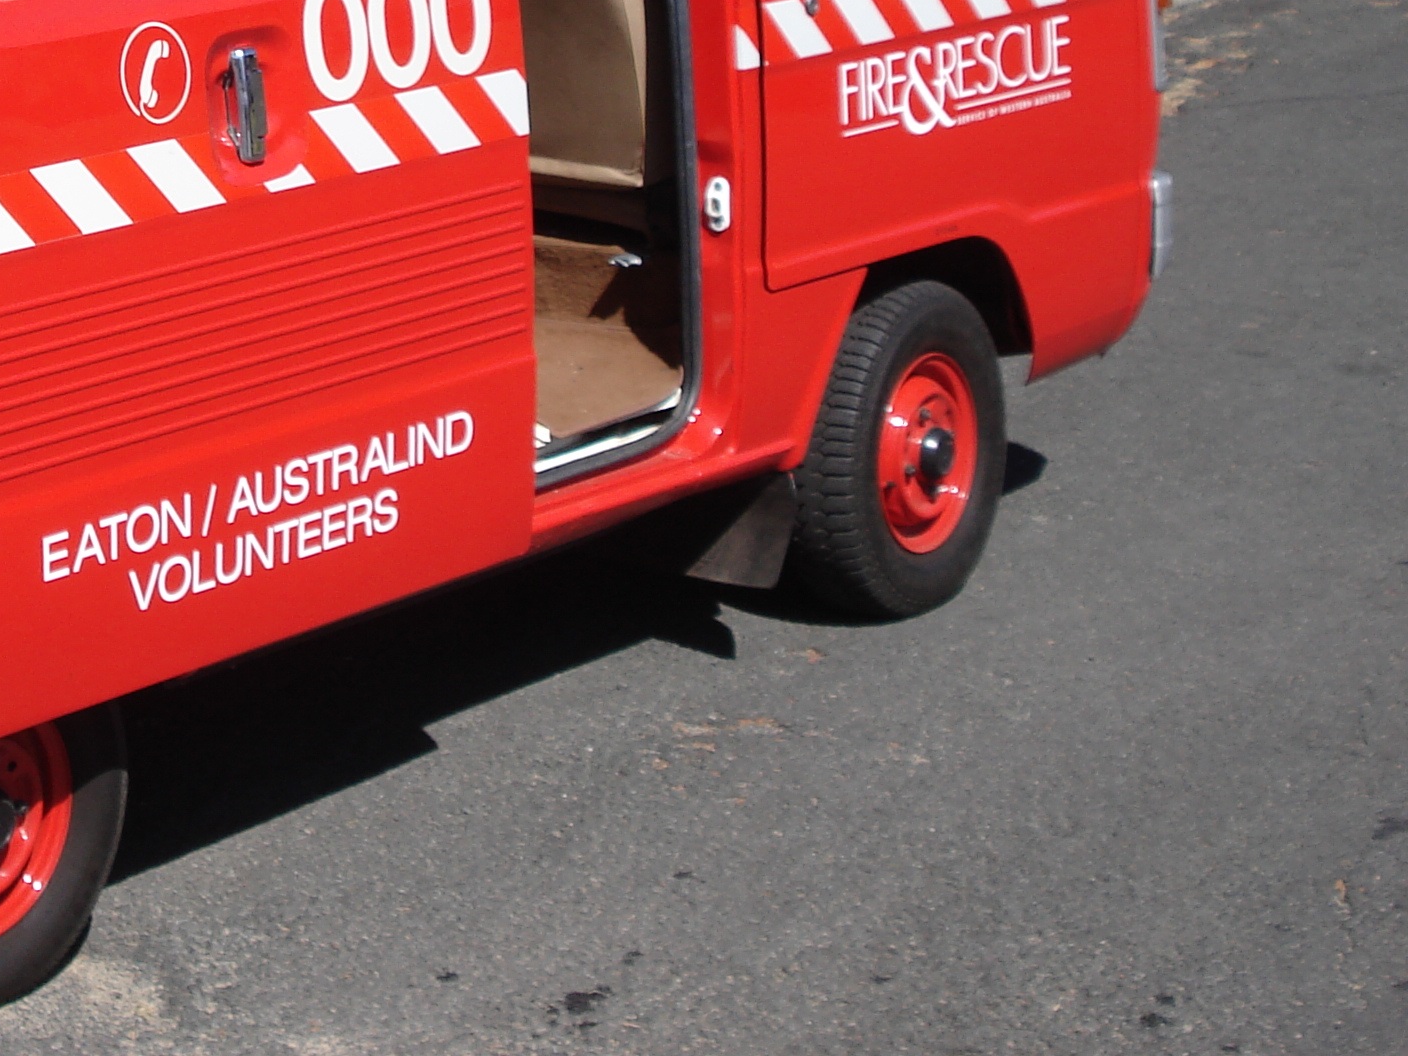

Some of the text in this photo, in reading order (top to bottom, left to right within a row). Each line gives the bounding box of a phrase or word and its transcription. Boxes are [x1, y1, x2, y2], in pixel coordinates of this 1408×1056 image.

[41, 410, 475, 583] EATON / AUSTRALIND
[128, 488, 399, 611] VOLUNTEERS
